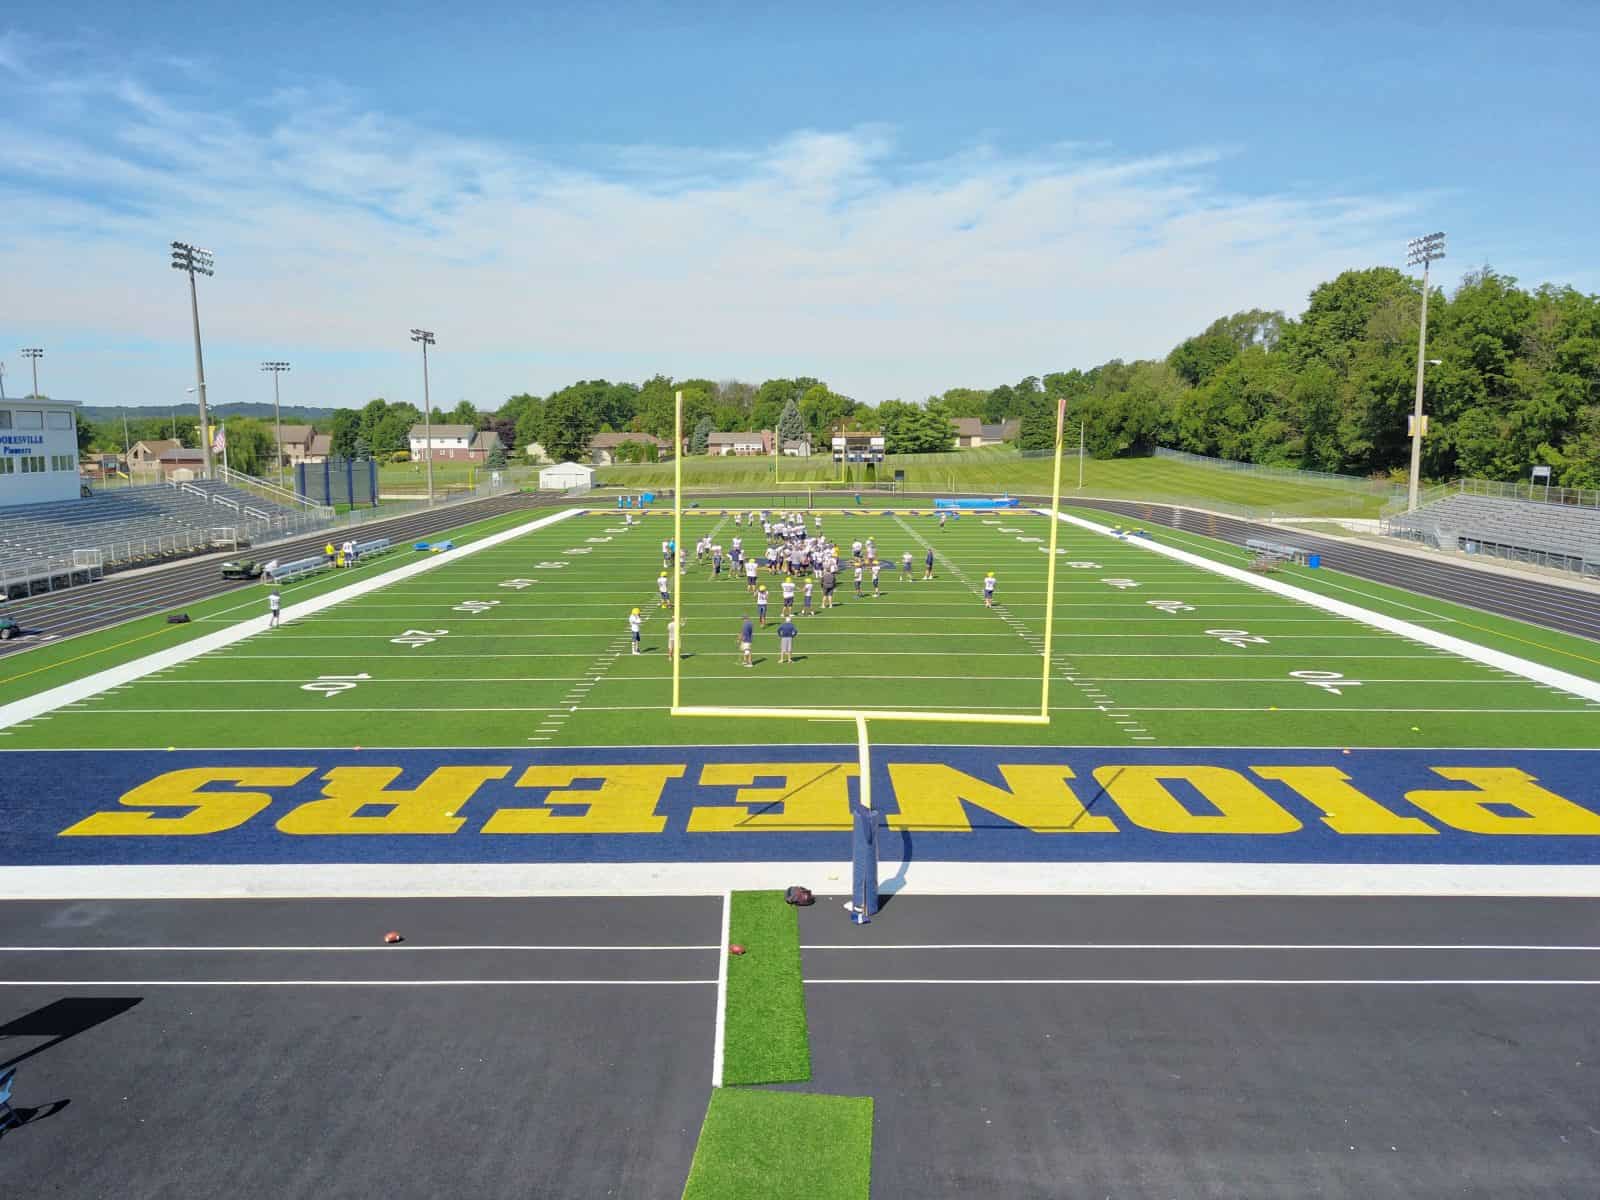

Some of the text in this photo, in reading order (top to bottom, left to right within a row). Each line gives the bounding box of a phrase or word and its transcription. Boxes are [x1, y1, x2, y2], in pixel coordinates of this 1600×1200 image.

[300, 672, 372, 690] 10
[1288, 670, 1362, 688] 10
[57, 762, 1600, 837] PIONEERS
